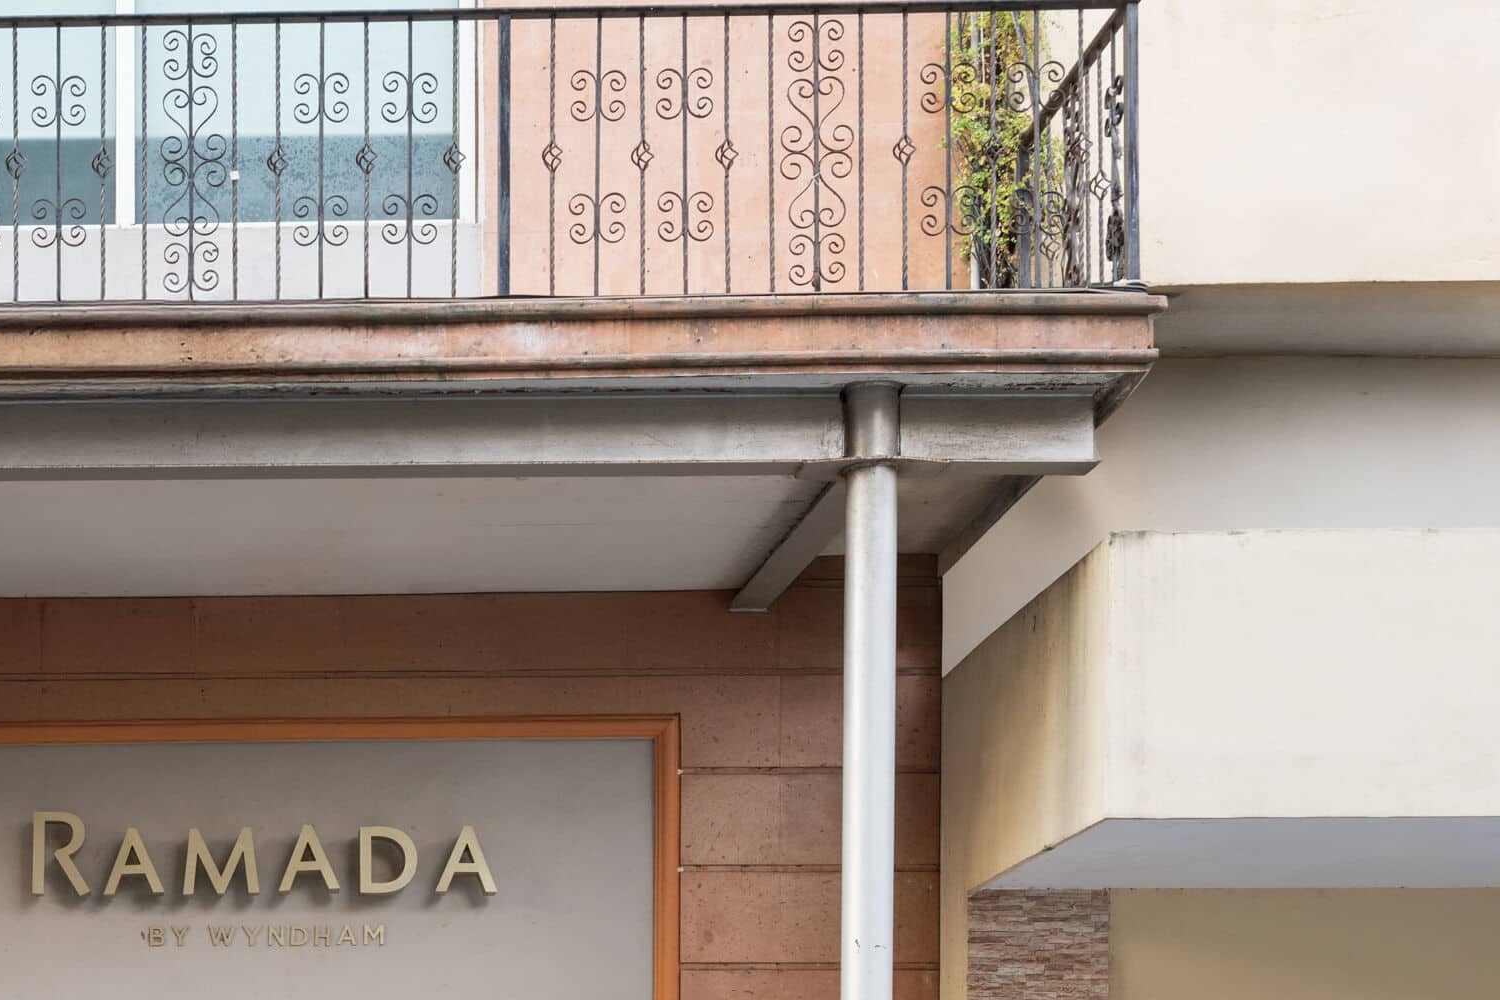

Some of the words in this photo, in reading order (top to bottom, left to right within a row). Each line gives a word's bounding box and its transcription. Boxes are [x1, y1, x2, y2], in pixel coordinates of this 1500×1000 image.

[31, 811, 498, 897] RAMADA
[148, 926, 190, 947] BY
[209, 924, 386, 947] WYNDHAM
